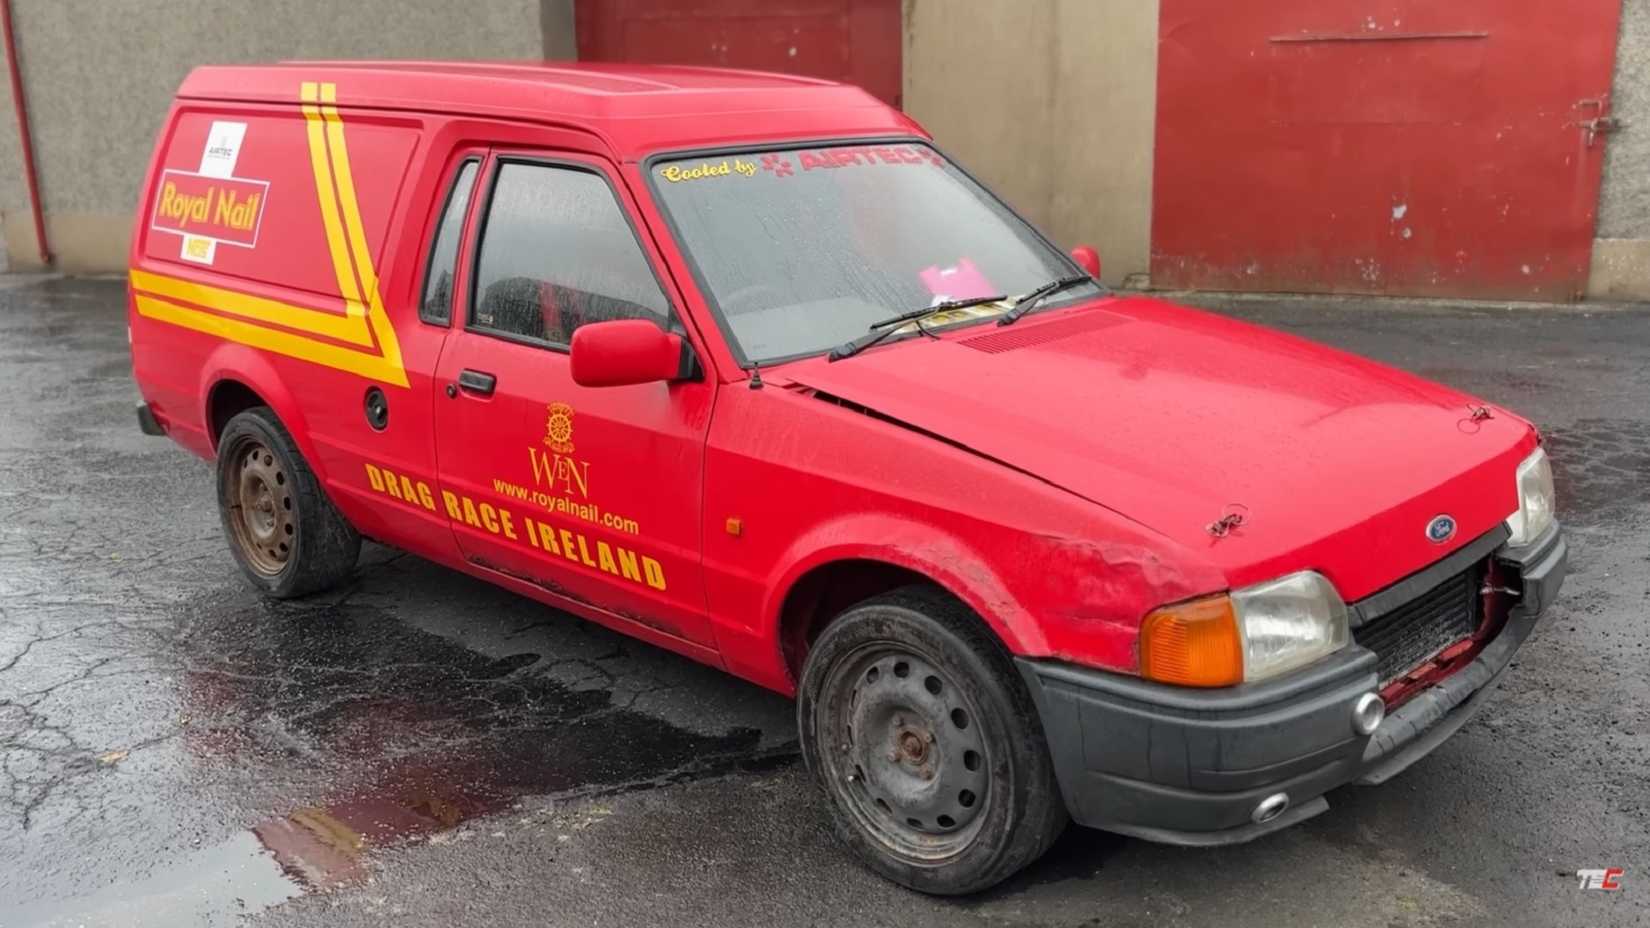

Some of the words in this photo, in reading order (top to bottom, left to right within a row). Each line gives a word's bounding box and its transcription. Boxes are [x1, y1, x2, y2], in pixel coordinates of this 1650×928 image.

[661, 159, 730, 182] Cooled
[735, 158, 757, 175] by
[798, 146, 923, 170] AIRTEC
[159, 181, 215, 228] Royal
[213, 187, 260, 231] Nail
[365, 463, 436, 511] DRAG
[442, 490, 517, 540] RACE
[525, 517, 667, 591] IRELAND
[493, 477, 639, 536] www.royalnail.com
